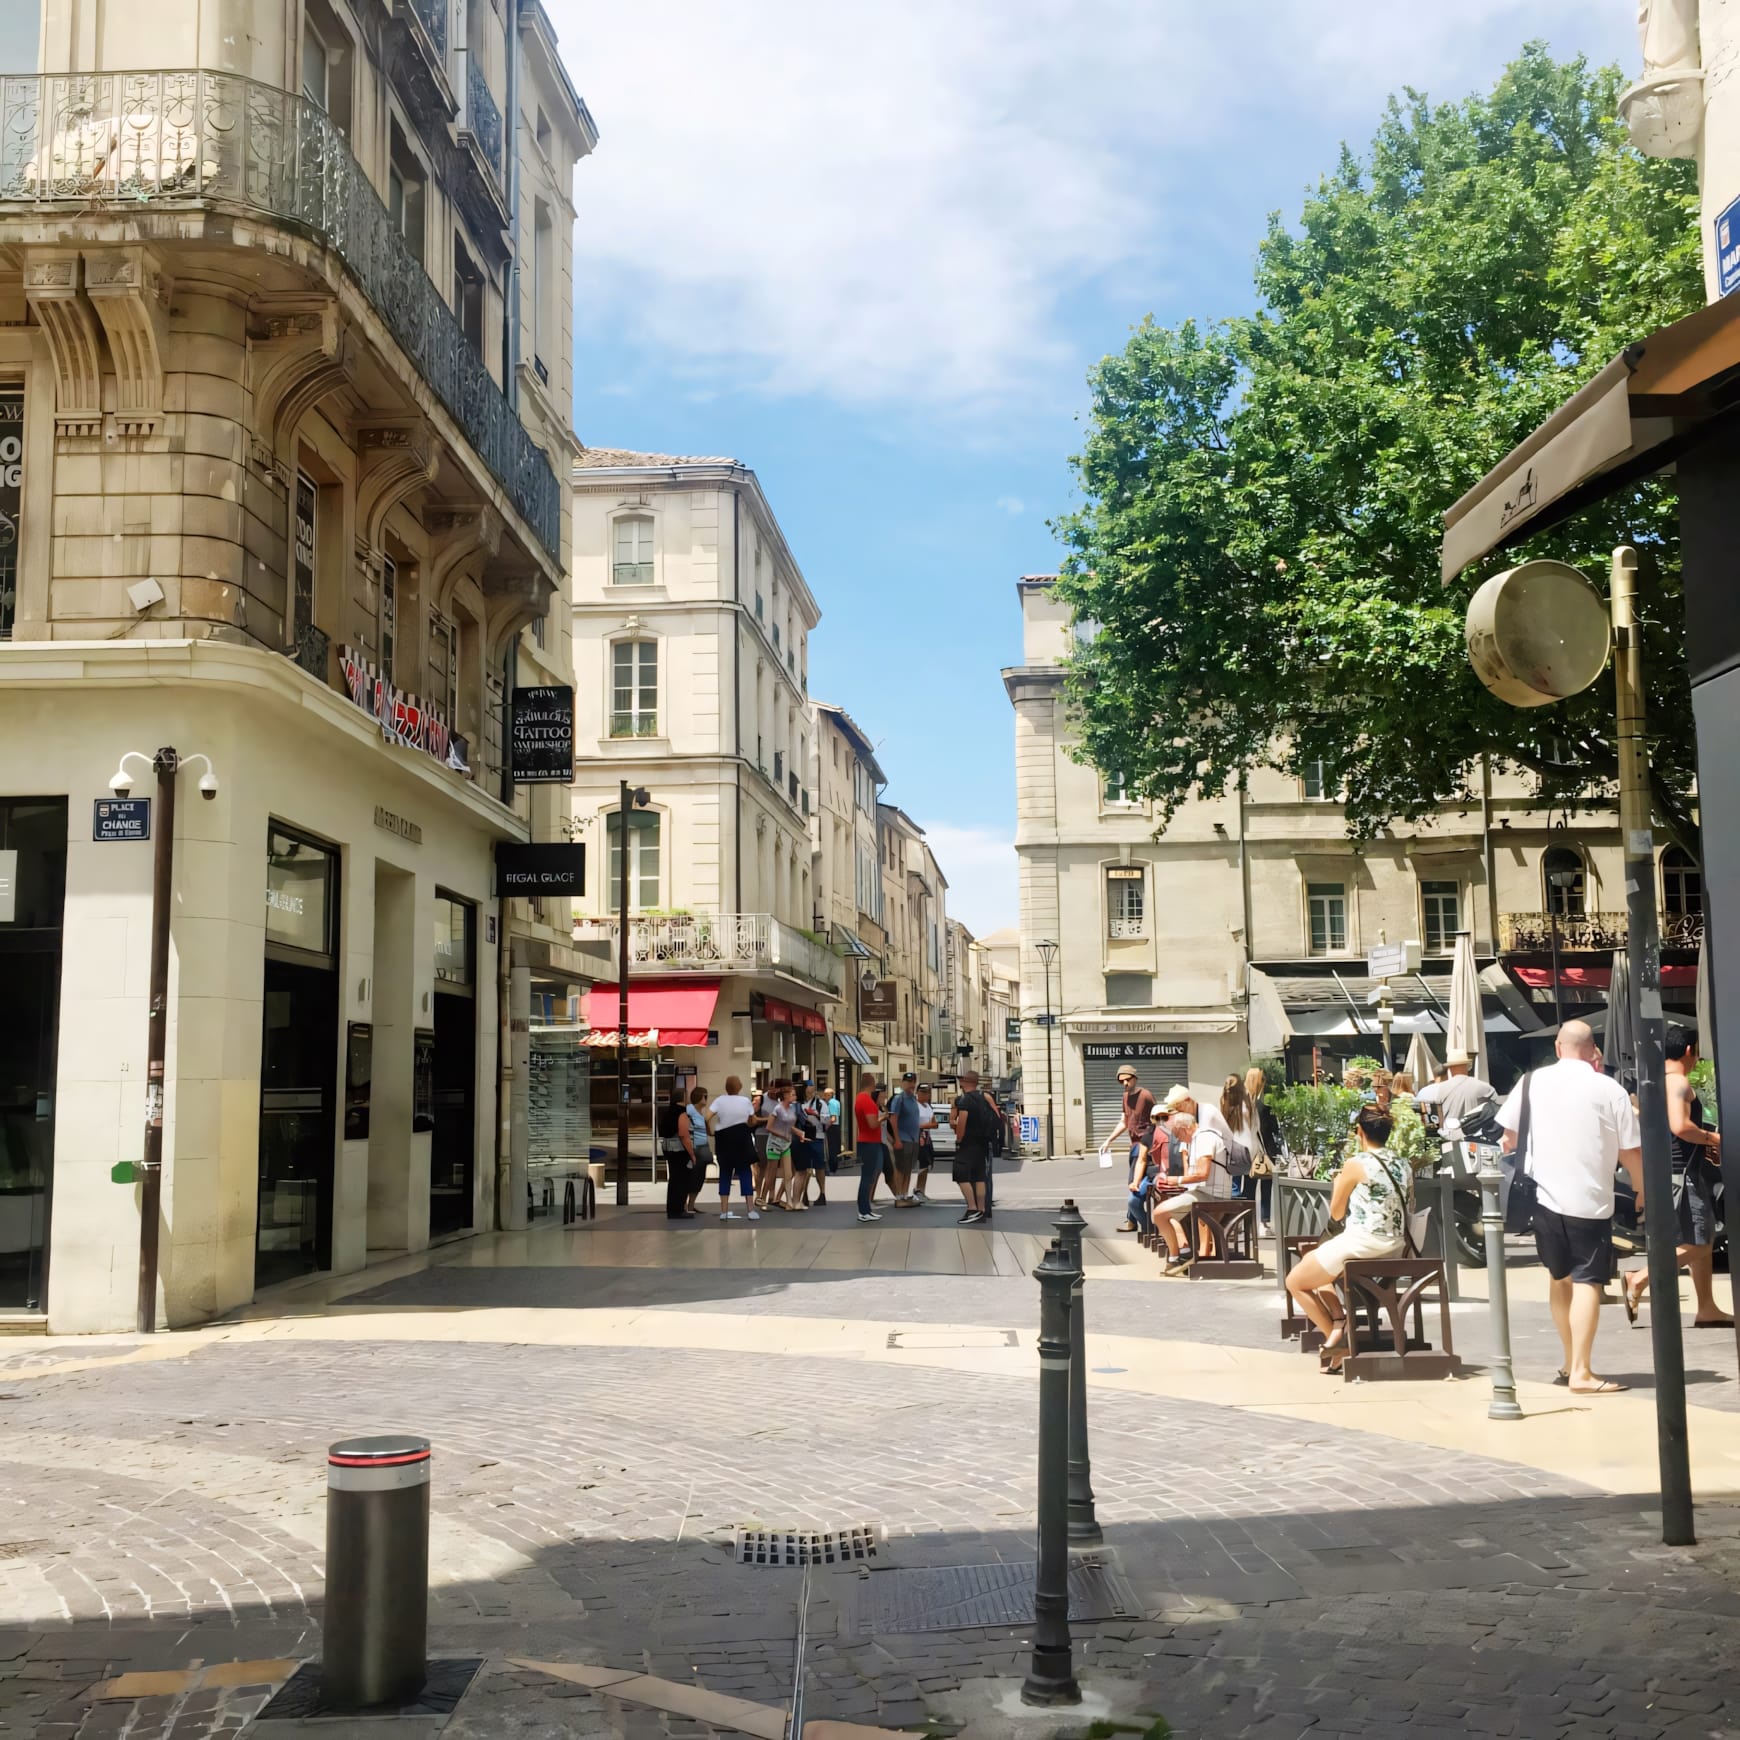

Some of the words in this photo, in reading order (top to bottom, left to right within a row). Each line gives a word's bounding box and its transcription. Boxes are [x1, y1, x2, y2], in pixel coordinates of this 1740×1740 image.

[513, 726, 572, 739] TATTOO
[111, 803, 134, 811] PLACE
[506, 873, 537, 883] REGAL
[540, 872, 575, 883] GLACE
[1087, 1045, 1121, 1058] Image
[1124, 1045, 1133, 1055] &
[1138, 1044, 1184, 1056] Ecriture
